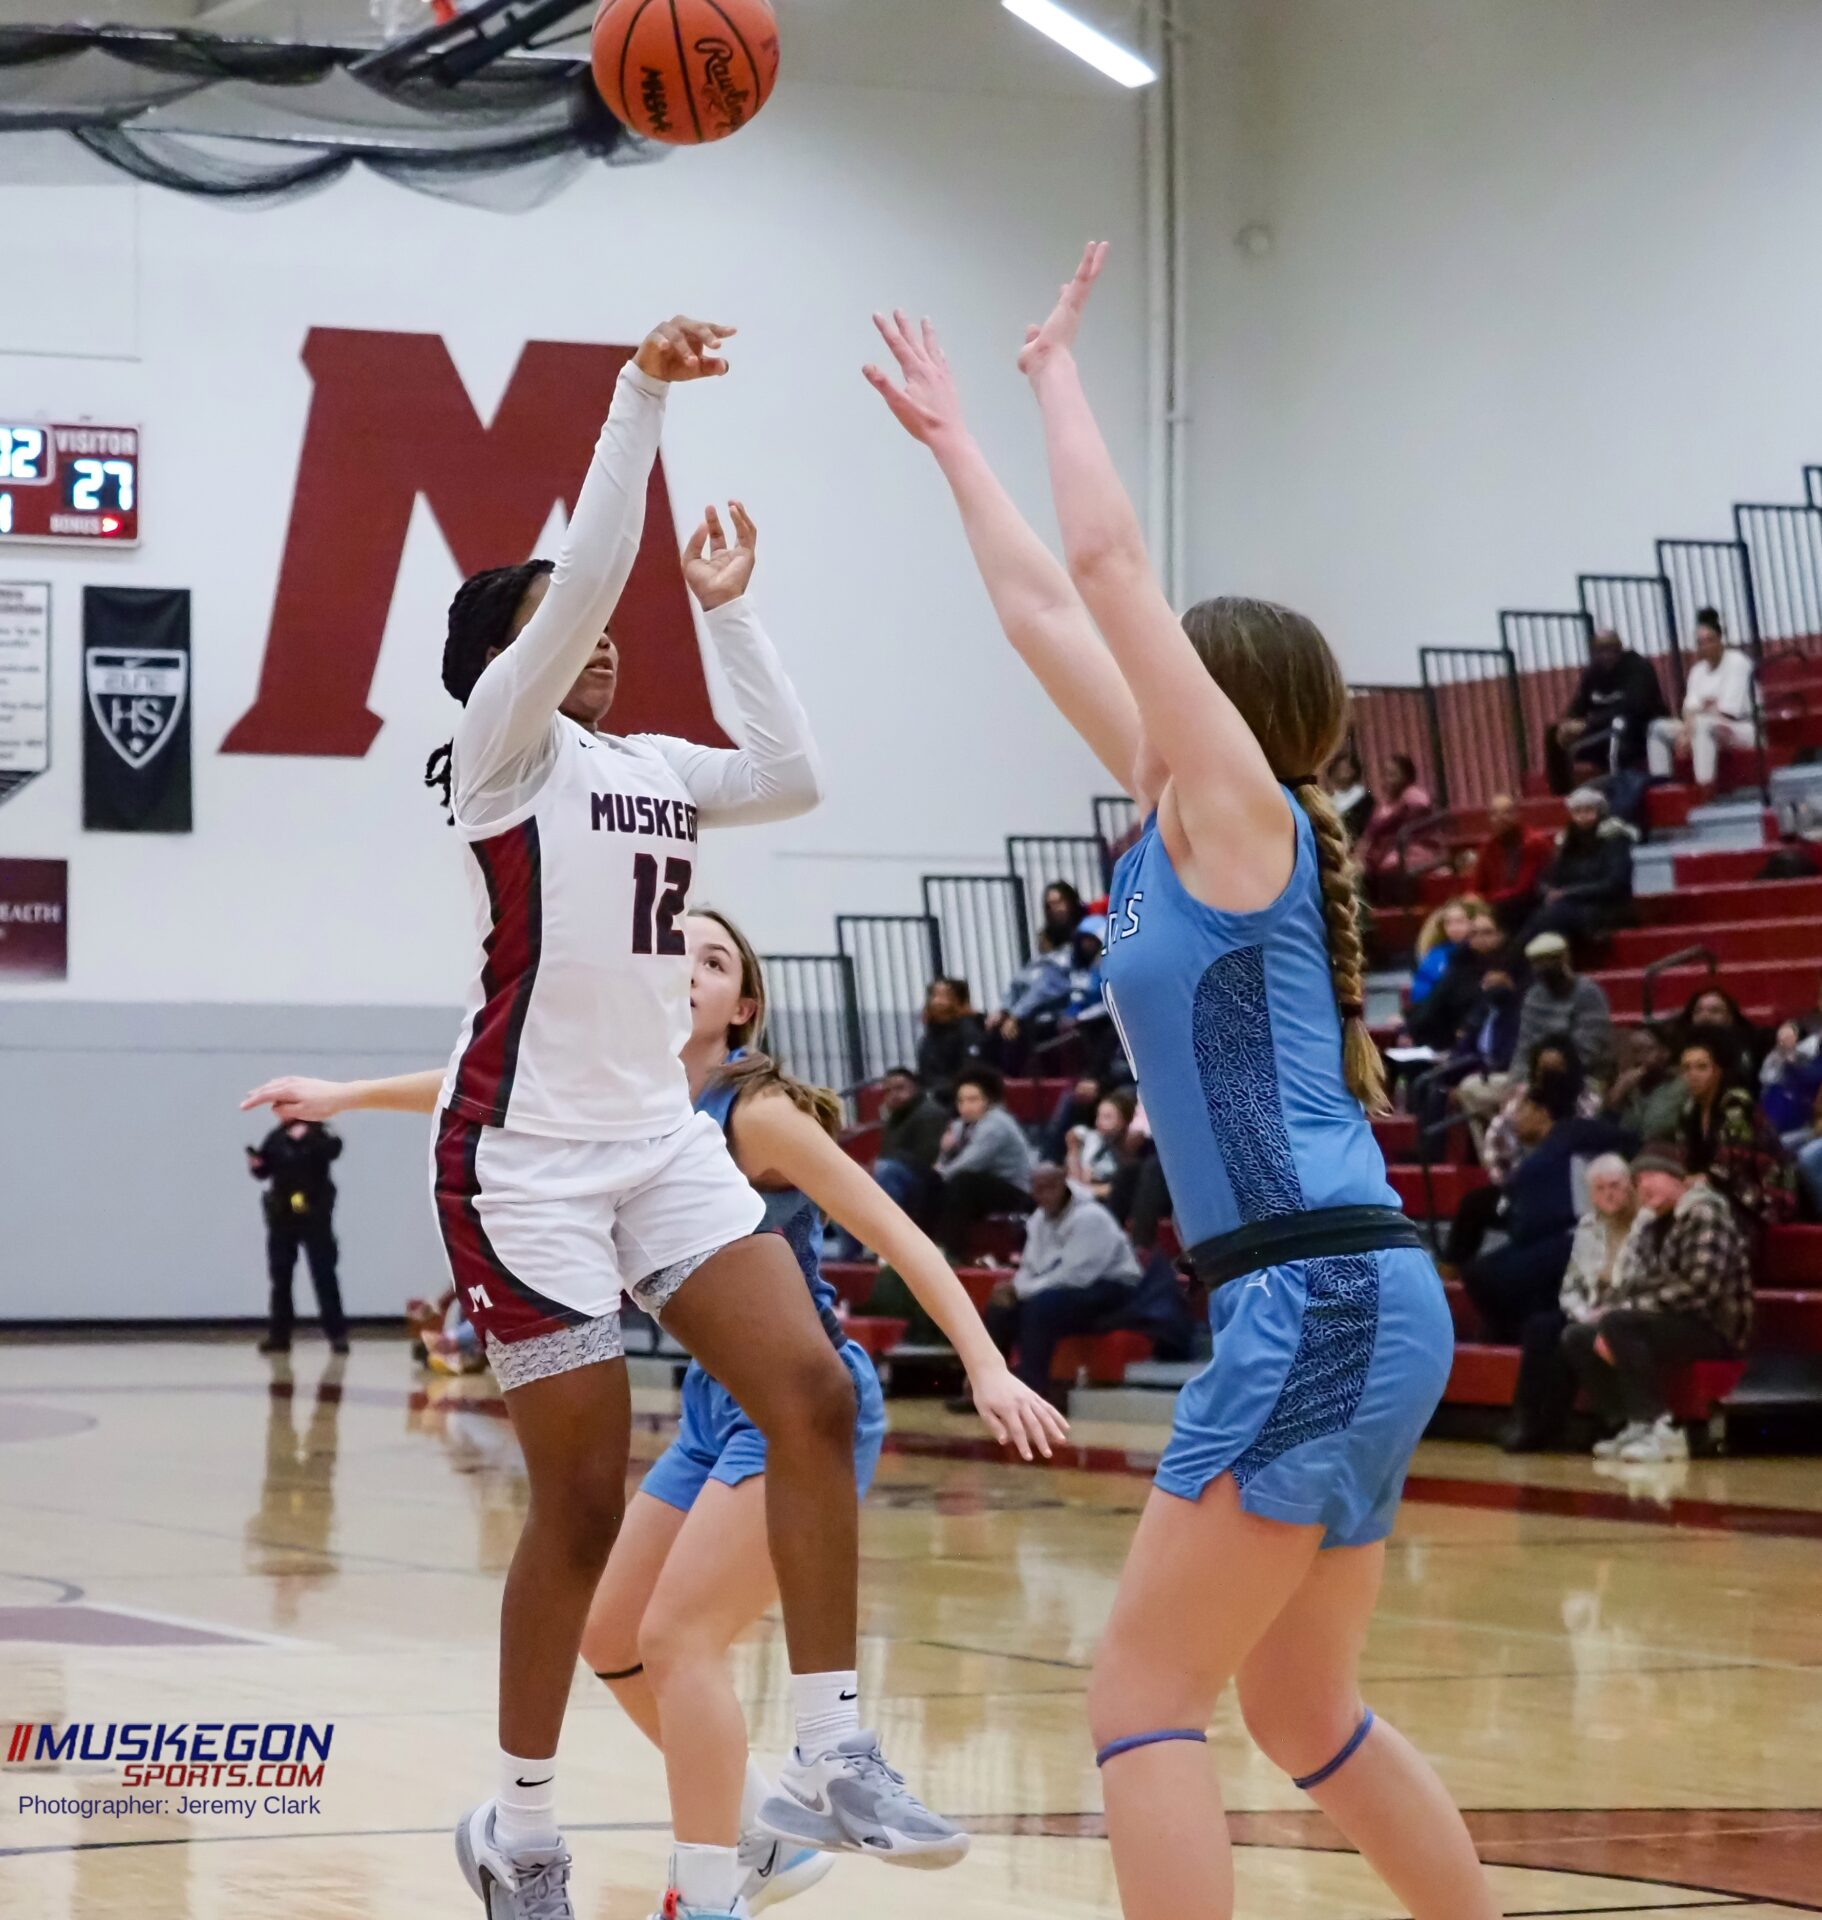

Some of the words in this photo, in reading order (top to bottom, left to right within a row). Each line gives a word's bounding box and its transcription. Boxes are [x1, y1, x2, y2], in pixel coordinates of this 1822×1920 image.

[55, 429, 137, 456] VISITOR
[73, 459, 134, 511] 27
[217, 326, 738, 757] M
[111, 696, 165, 735] HS
[591, 792, 698, 845] MUSKEG
[632, 852, 692, 956] 12
[467, 1284, 494, 1313] M
